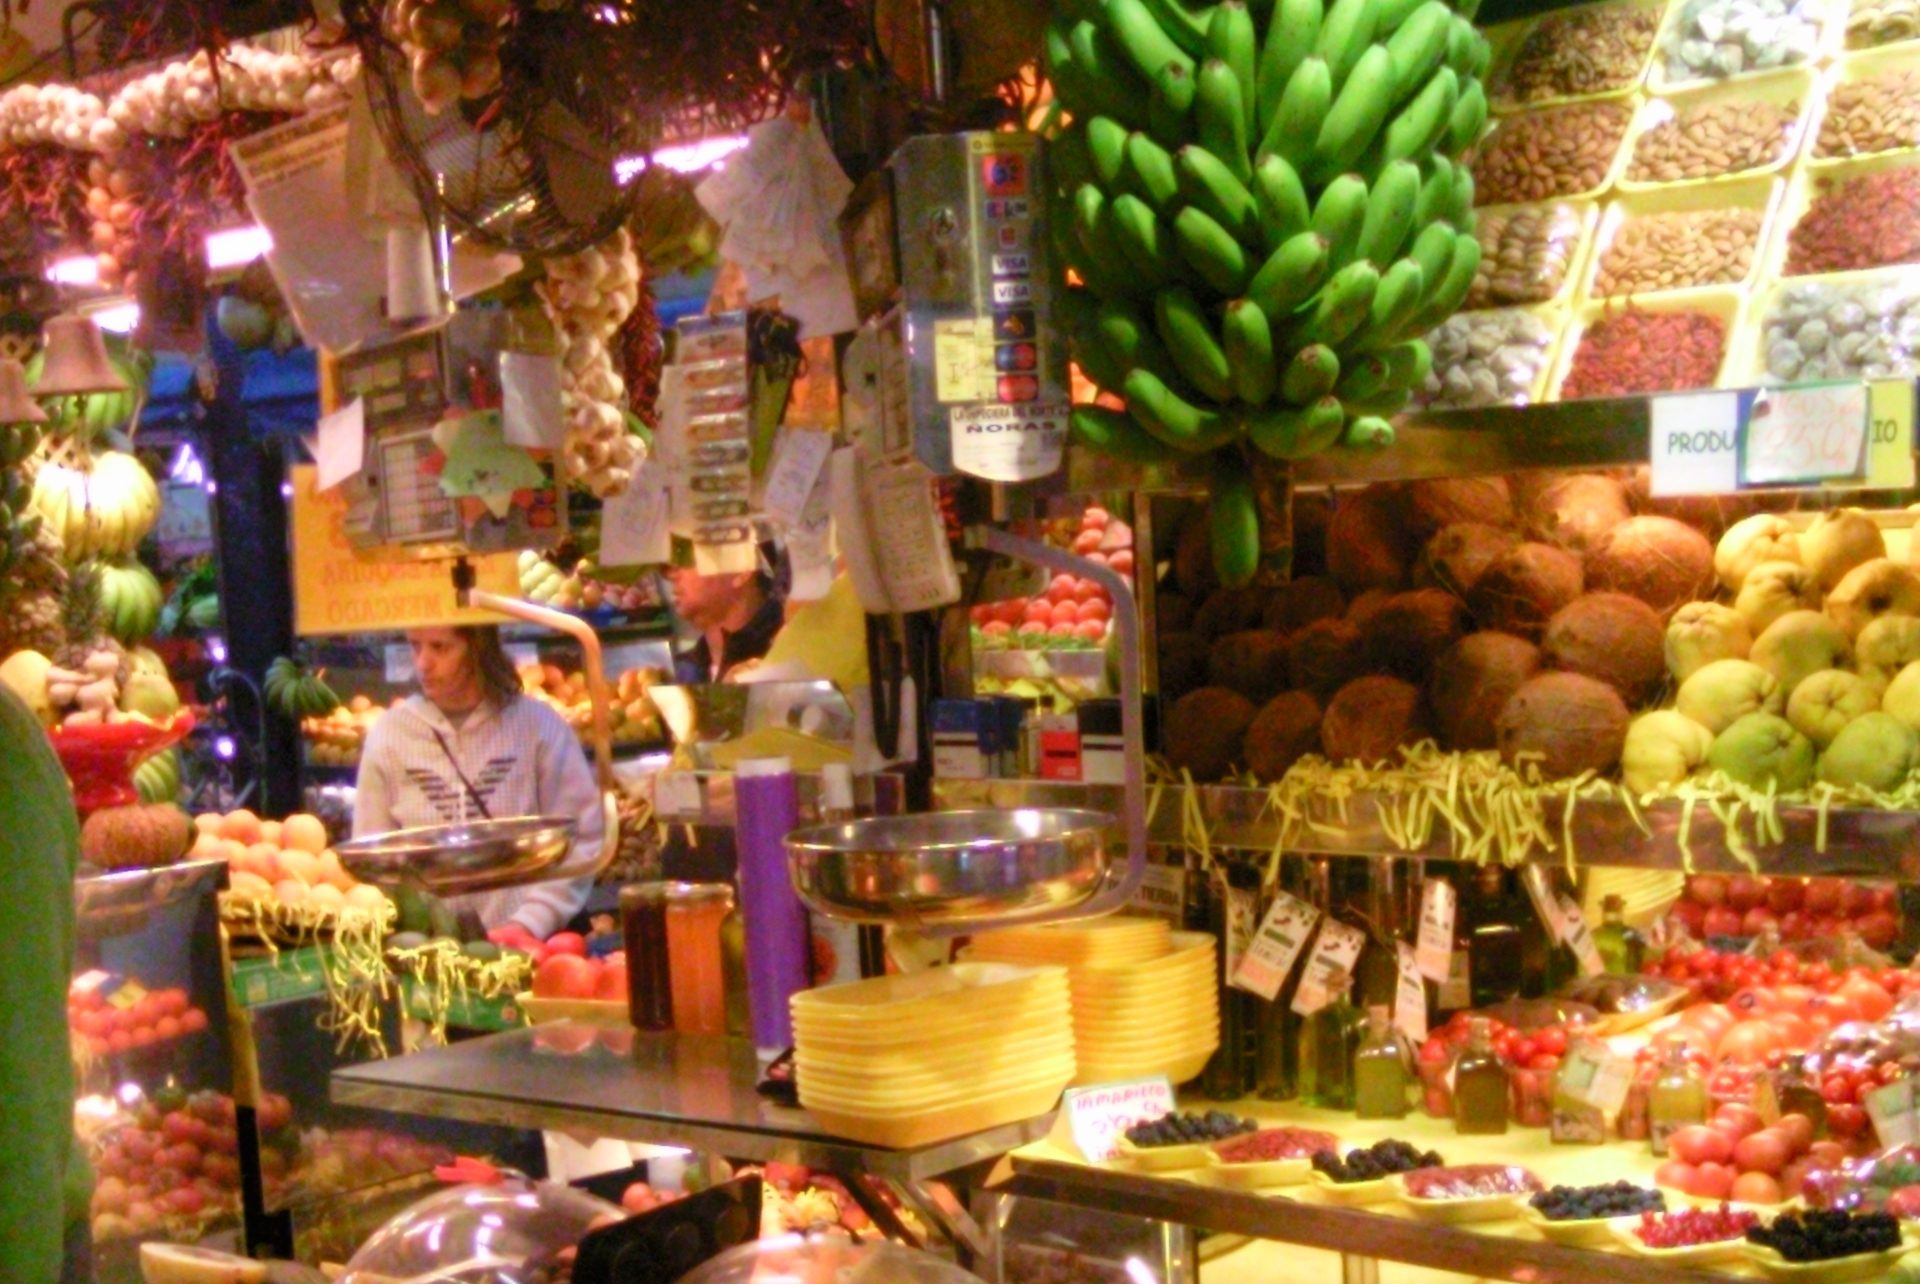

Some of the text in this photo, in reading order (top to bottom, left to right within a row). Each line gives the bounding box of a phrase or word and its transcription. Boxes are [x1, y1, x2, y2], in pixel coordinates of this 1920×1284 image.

[999, 285, 1029, 297] VISA
[1667, 419, 1899, 452] PRODU IO
